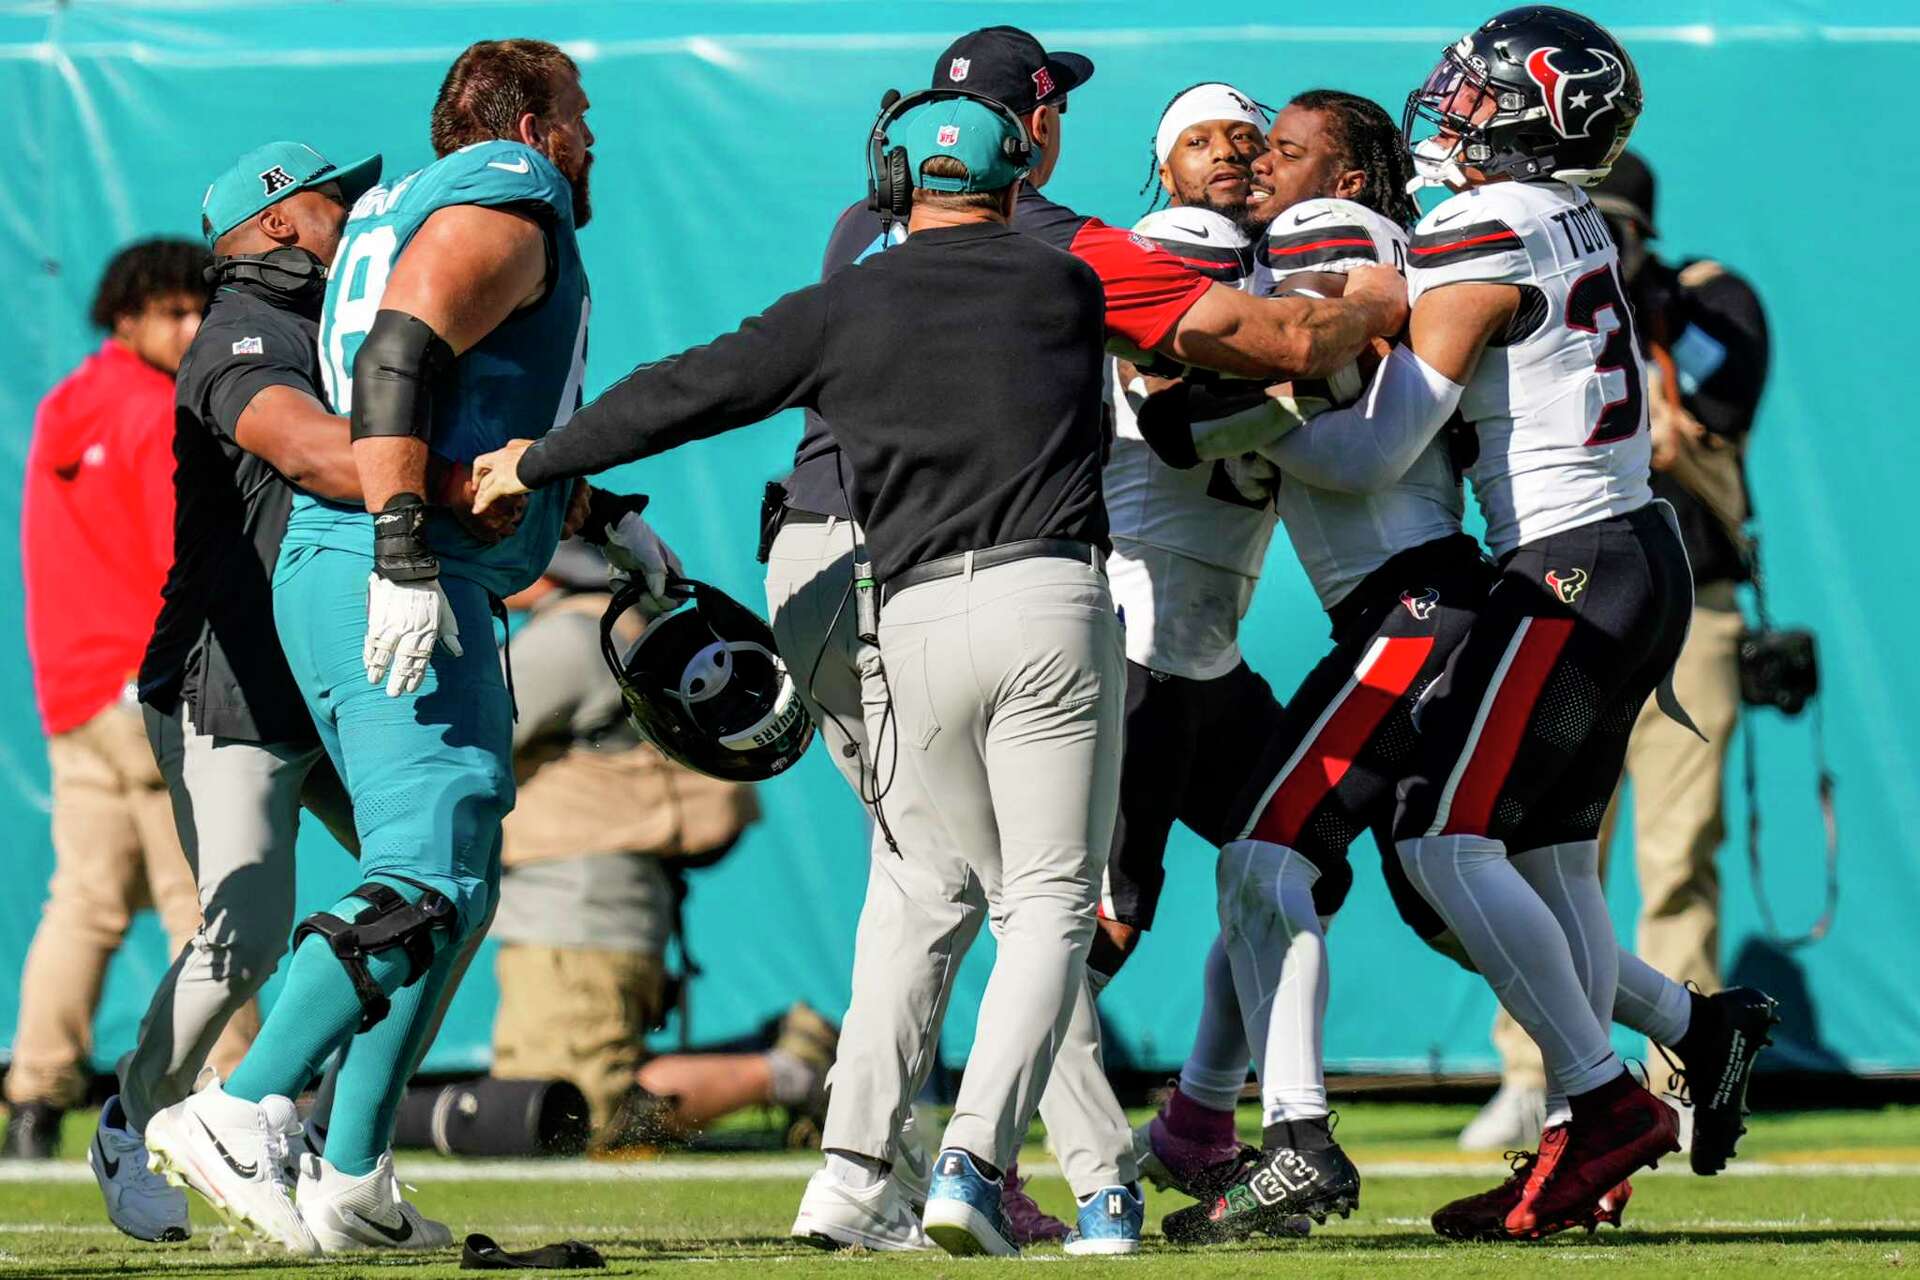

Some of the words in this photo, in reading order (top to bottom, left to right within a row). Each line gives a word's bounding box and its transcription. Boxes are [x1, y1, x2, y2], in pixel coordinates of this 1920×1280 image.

[259, 165, 296, 197] A
[318, 224, 396, 415] 8
[1565, 260, 1650, 446] 3
[943, 1156, 958, 1175] F
[1108, 1193, 1122, 1215] H
